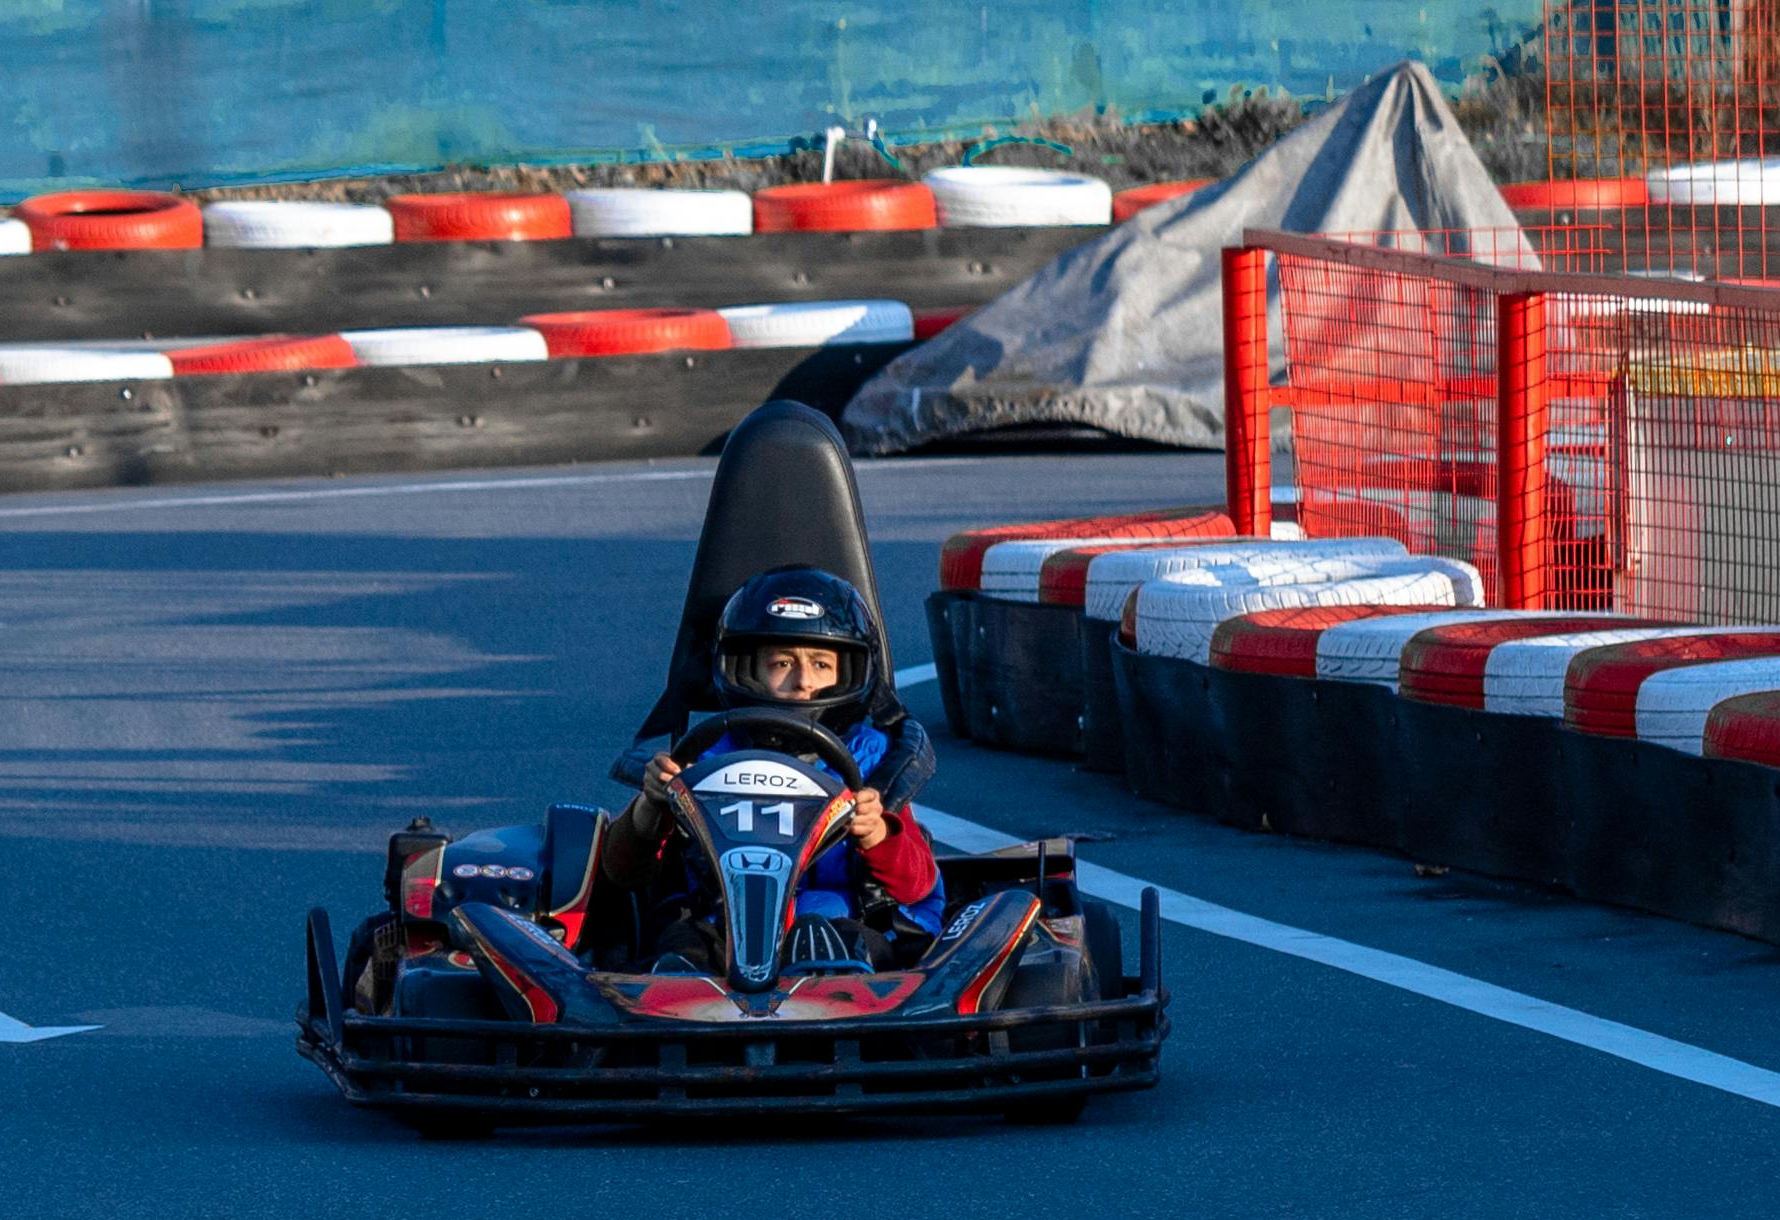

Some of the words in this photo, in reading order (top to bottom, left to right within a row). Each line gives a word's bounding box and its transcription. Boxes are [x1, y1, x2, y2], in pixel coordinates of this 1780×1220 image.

[724, 773, 798, 789] LEROZ
[720, 800, 794, 836] 11
[942, 902, 986, 940] LEROZ
